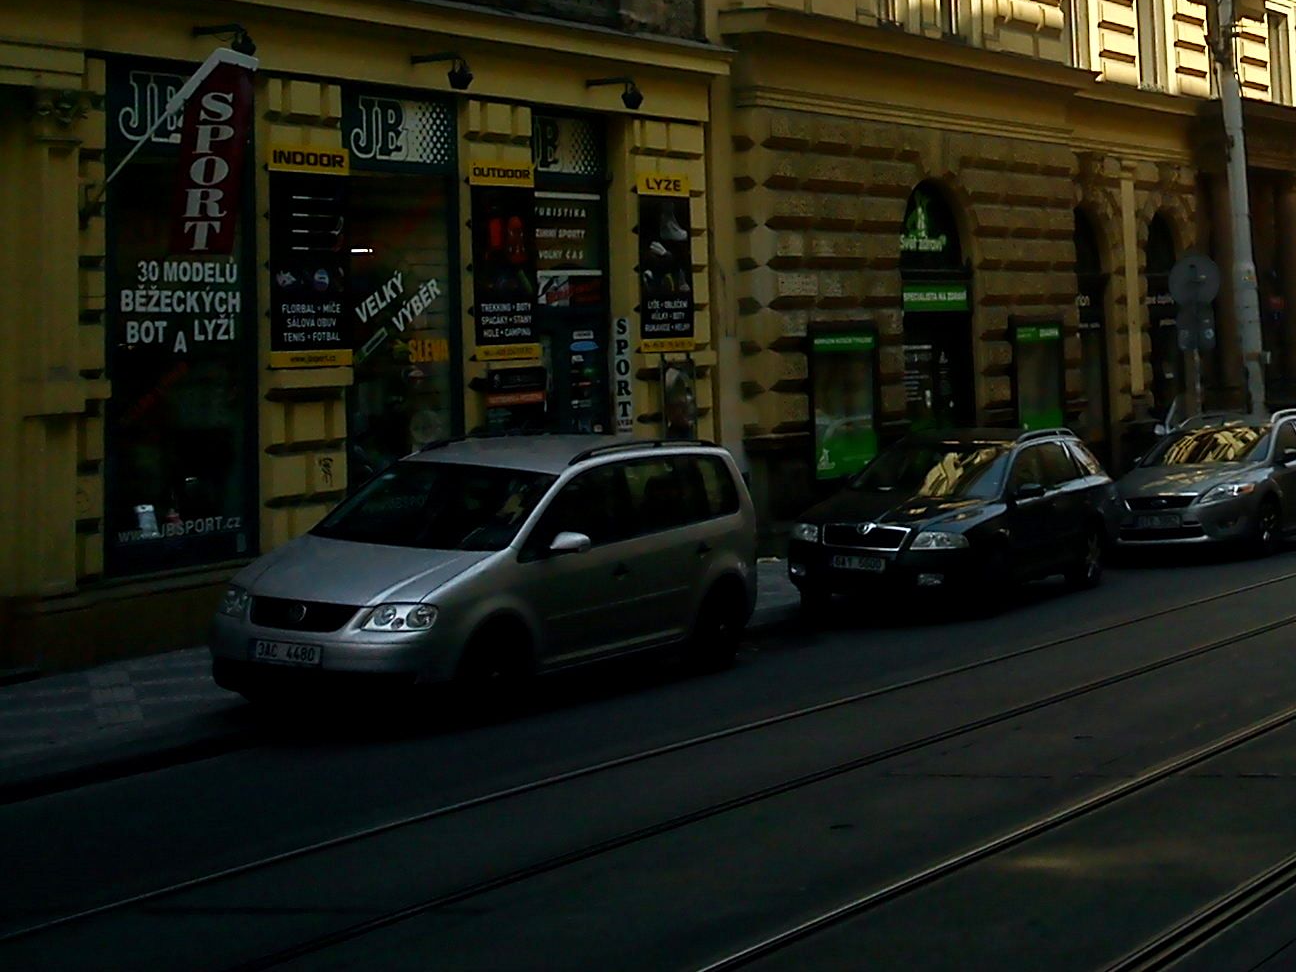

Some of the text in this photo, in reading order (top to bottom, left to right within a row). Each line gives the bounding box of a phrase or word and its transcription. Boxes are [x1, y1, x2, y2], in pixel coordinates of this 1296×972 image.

[350, 95, 409, 163] JB
[182, 91, 236, 252] SPORT
[273, 149, 345, 168] INDOOR
[473, 166, 531, 179] OUTDOOR
[137, 257, 238, 284] 30 MODELŮ
[120, 285, 241, 314] BĚŽECKÝCH
[354, 269, 406, 324] VELKÝ
[391, 278, 443, 334] VÝBĚR
[125, 315, 236, 354] BOT A LYŽÍ
[283, 331, 341, 342] TENIS FOTBAL
[615, 318, 632, 418] SPORT
